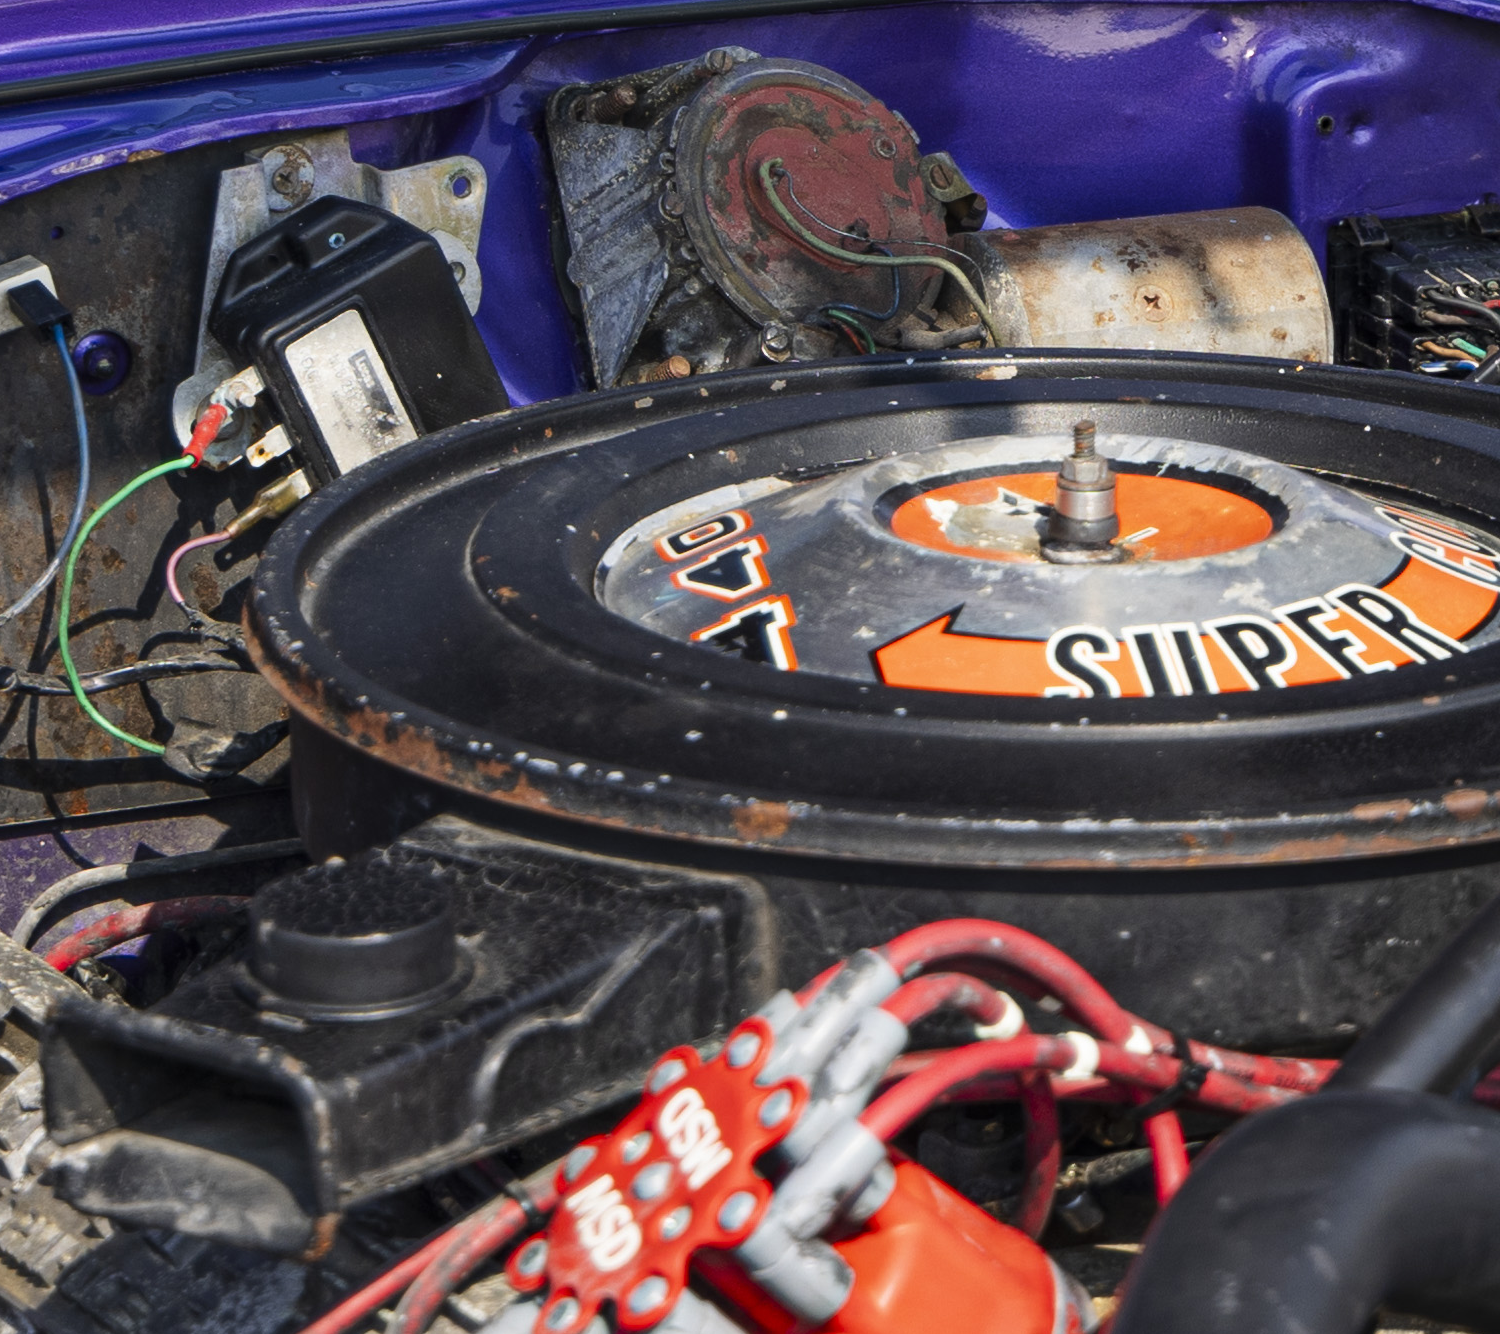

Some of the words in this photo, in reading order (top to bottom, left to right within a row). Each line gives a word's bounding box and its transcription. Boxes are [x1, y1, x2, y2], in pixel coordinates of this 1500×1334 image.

[656, 509, 799, 672] 440
[1044, 582, 1470, 701] SUPER
[658, 1086, 733, 1191] MSD
[565, 1174, 643, 1271] MSD
